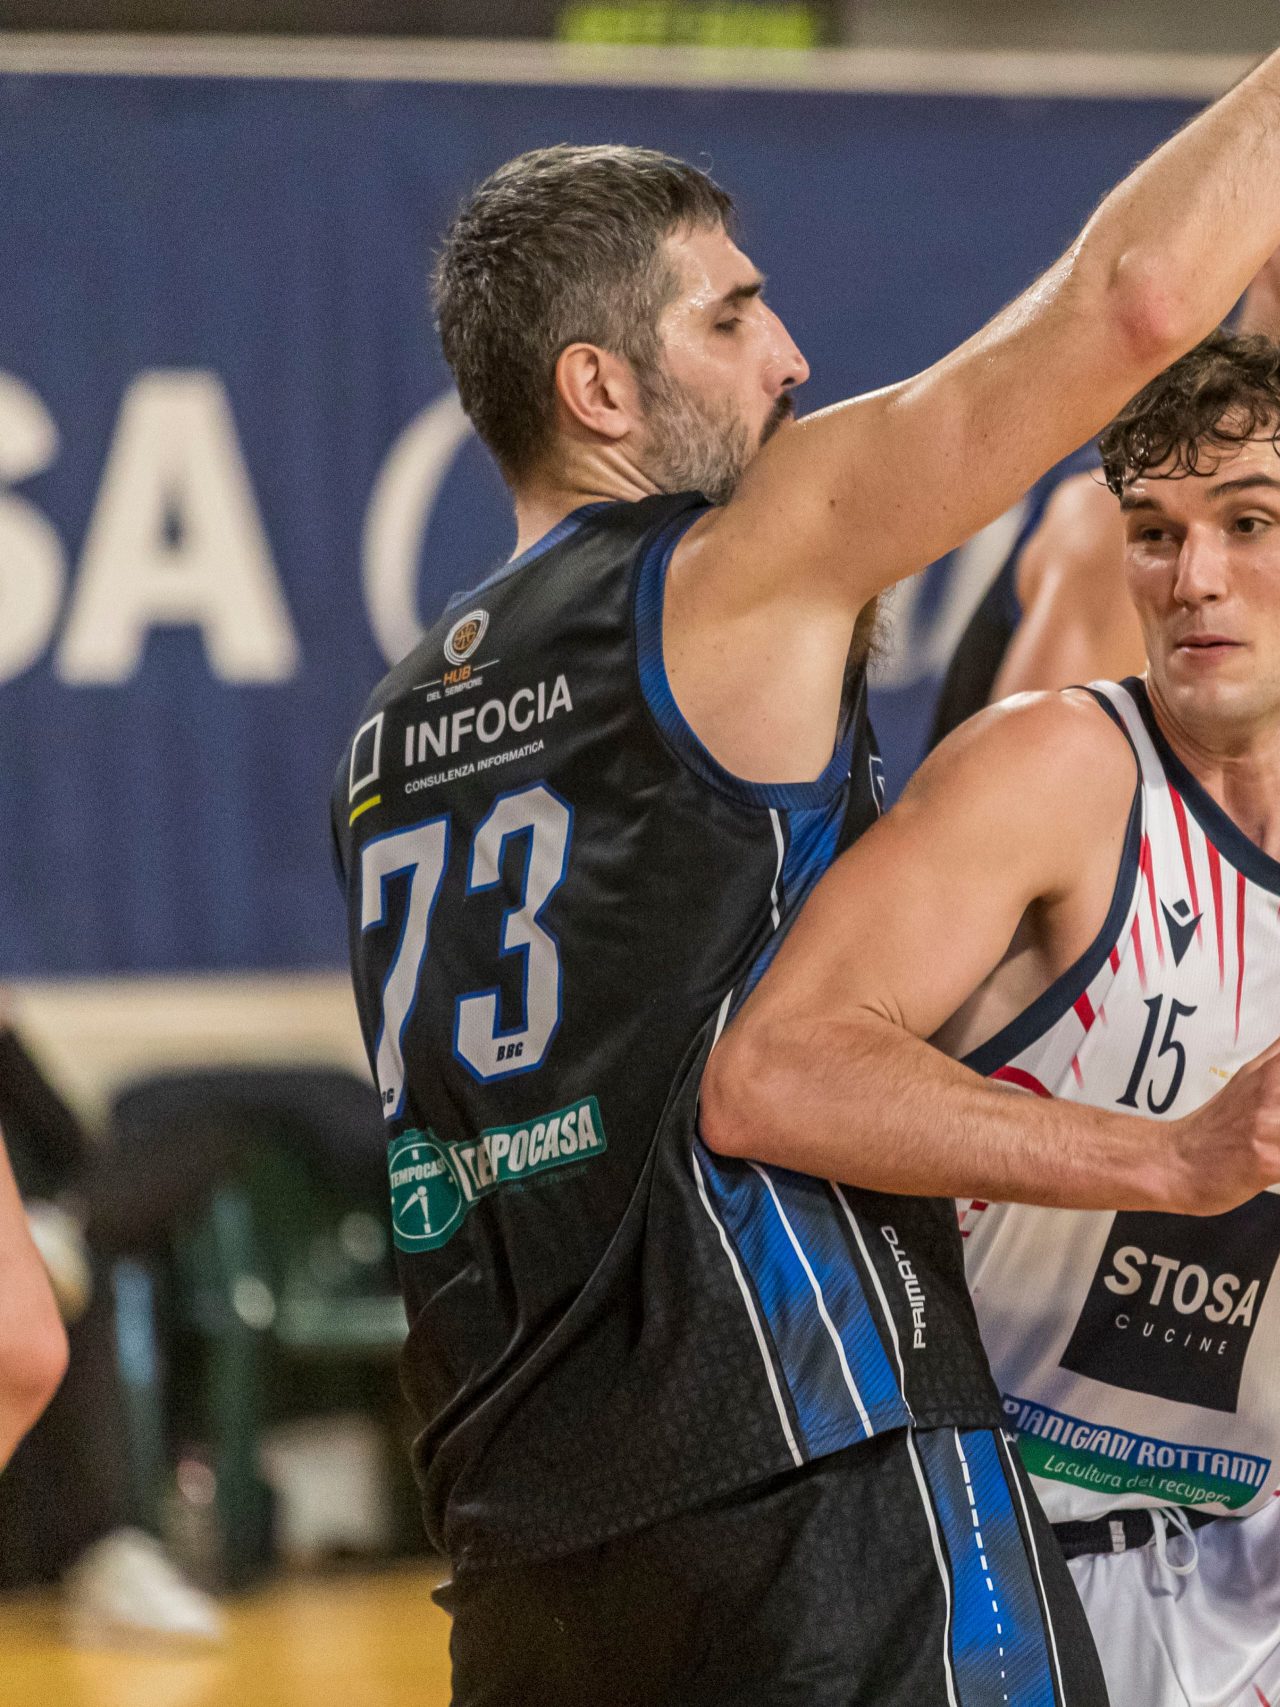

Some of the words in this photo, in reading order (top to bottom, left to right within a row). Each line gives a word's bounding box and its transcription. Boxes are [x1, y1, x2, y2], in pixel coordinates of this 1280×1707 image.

[426, 690, 441, 702] DEL
[443, 664, 472, 686] HUB
[404, 673, 574, 767] INFOCIA
[404, 765, 475, 795] CONSULENZA
[477, 739, 545, 773] INFORMATICA
[360, 779, 574, 1121] 73
[496, 1041, 524, 1063] BBG
[1115, 993, 1198, 1114] 15
[881, 1225, 926, 1349] PRIMATO
[1103, 1245, 1261, 1328] STOSA
[1115, 1313, 1228, 1355] CUCINE
[1043, 1454, 1064, 1473] La
[1065, 1461, 1121, 1488] cultura
[1126, 1474, 1155, 1489] del
[1136, 1441, 1267, 1488] ROTTAMI
